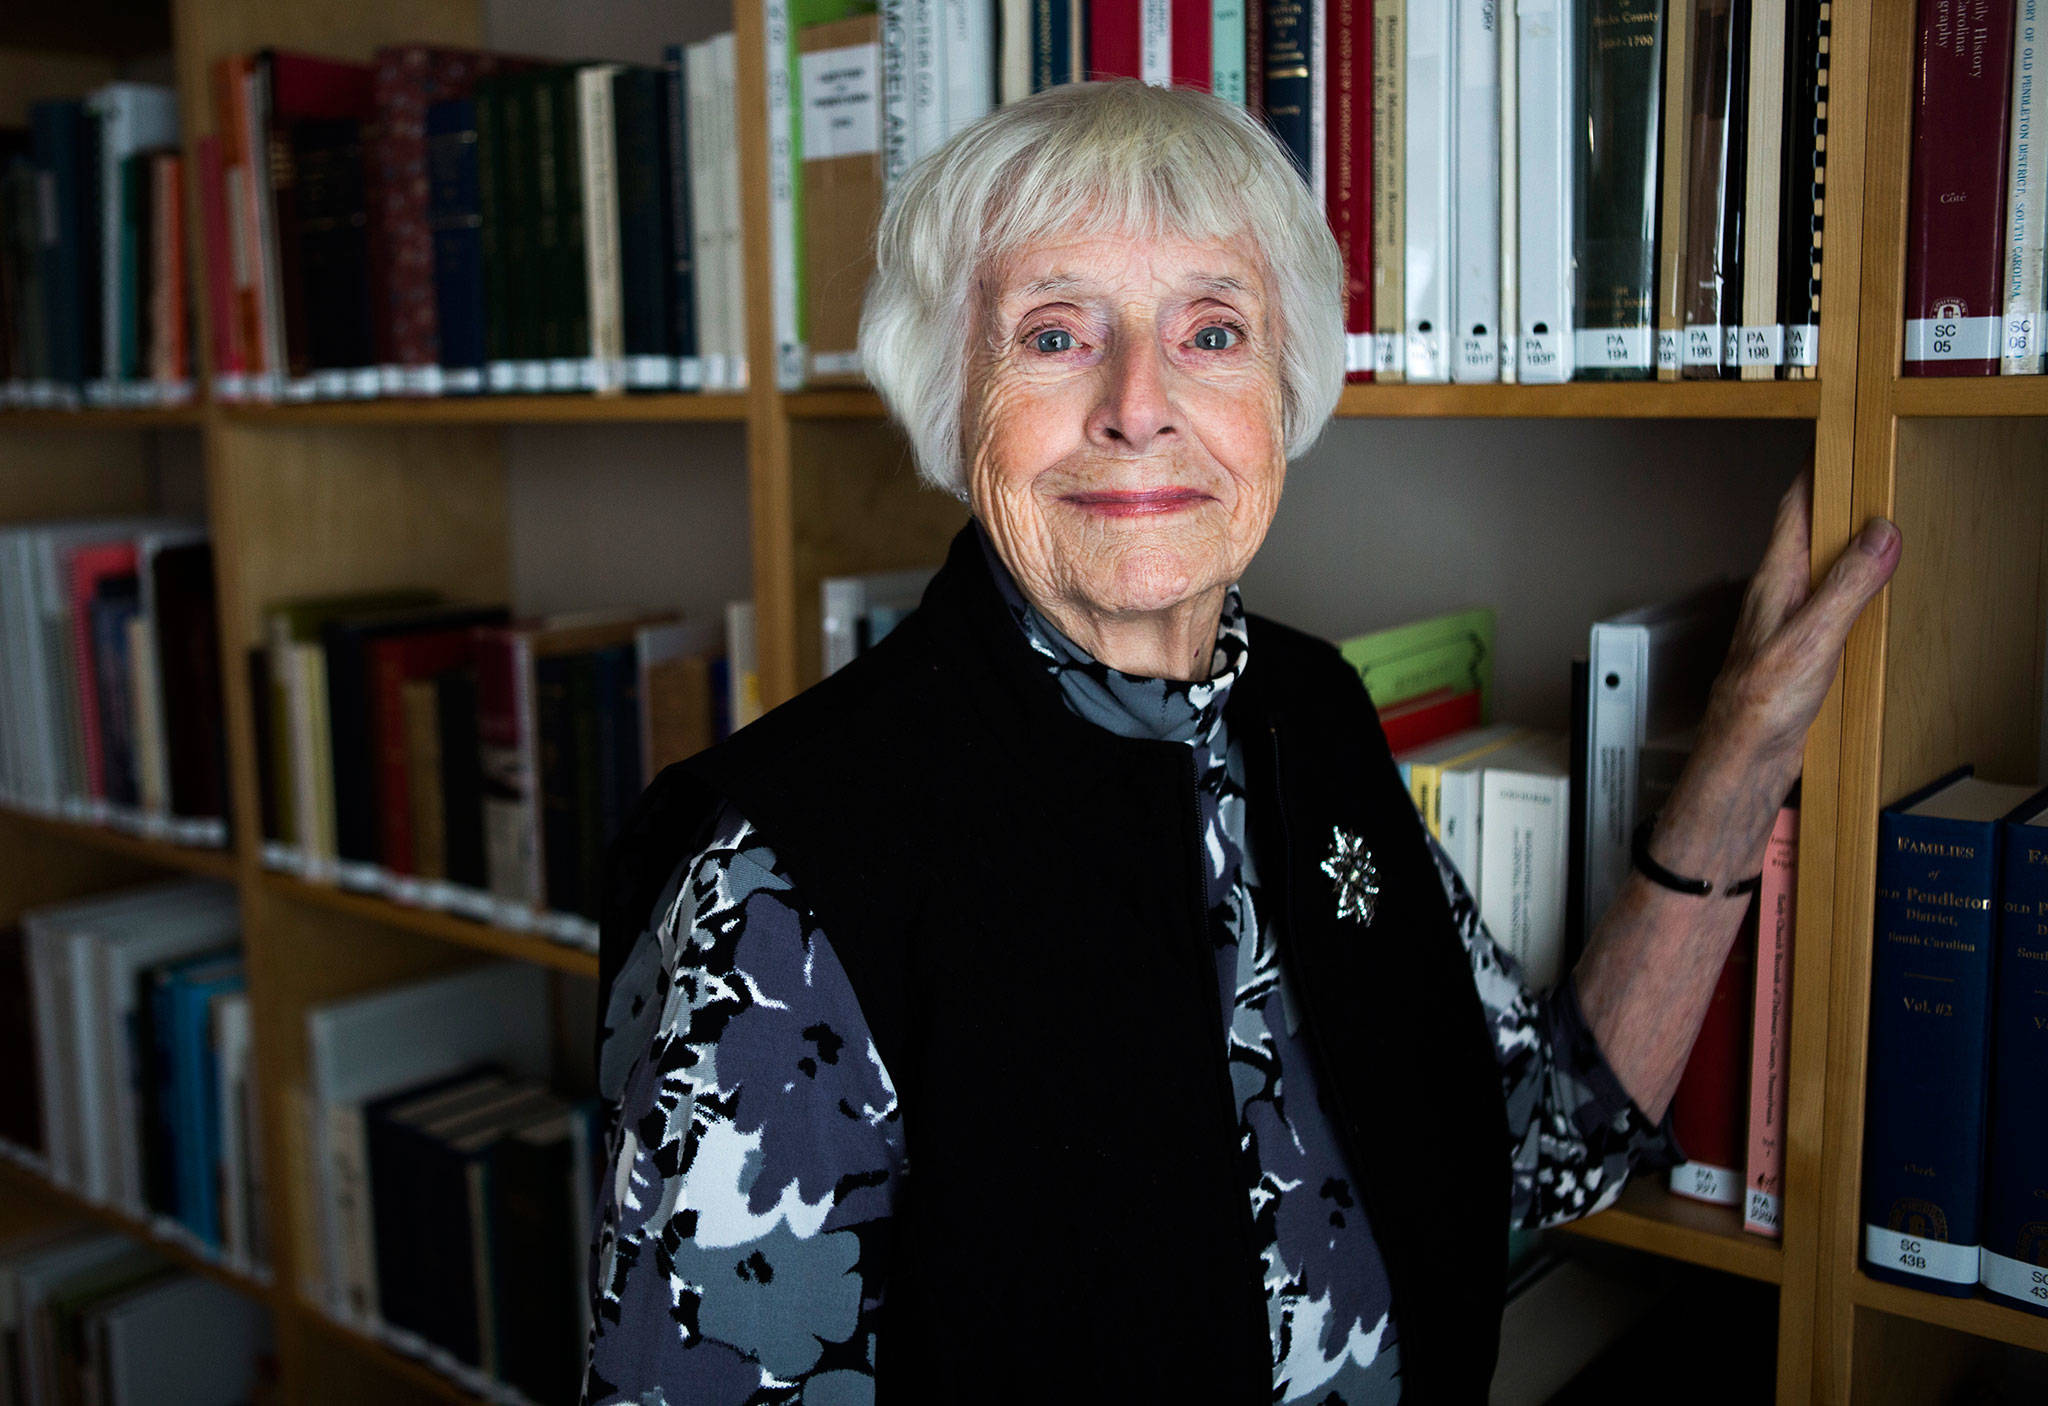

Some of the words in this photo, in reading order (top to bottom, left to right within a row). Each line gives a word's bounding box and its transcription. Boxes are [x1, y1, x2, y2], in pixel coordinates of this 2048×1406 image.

[2024, 28, 2035, 42] OF
[1969, 28, 1988, 79] History
[2022, 48, 2034, 71] OLD
[2018, 74, 2033, 140] PENDLETON
[2013, 203, 2025, 242] SOUTH
[2011, 246, 2023, 298] CAROLINA
[1934, 325, 1956, 338] SC
[2009, 320, 2032, 333] SC
[1606, 334, 1625, 345] PA
[1690, 331, 1709, 343] PA
[1746, 331, 1765, 343] PA
[2009, 336, 2027, 350] 06
[1526, 340, 1543, 351] PA
[1933, 341, 1951, 352] 05
[1897, 835, 1975, 860] FAMILIES
[1928, 869, 1941, 881] of
[1906, 887, 1992, 911] Pendleton
[2004, 902, 2031, 914] OLD
[1887, 931, 1921, 946] South
[1923, 936, 1976, 953] Carolina
[1899, 1238, 1921, 1253] SC
[1898, 1253, 1927, 1269] 43B
